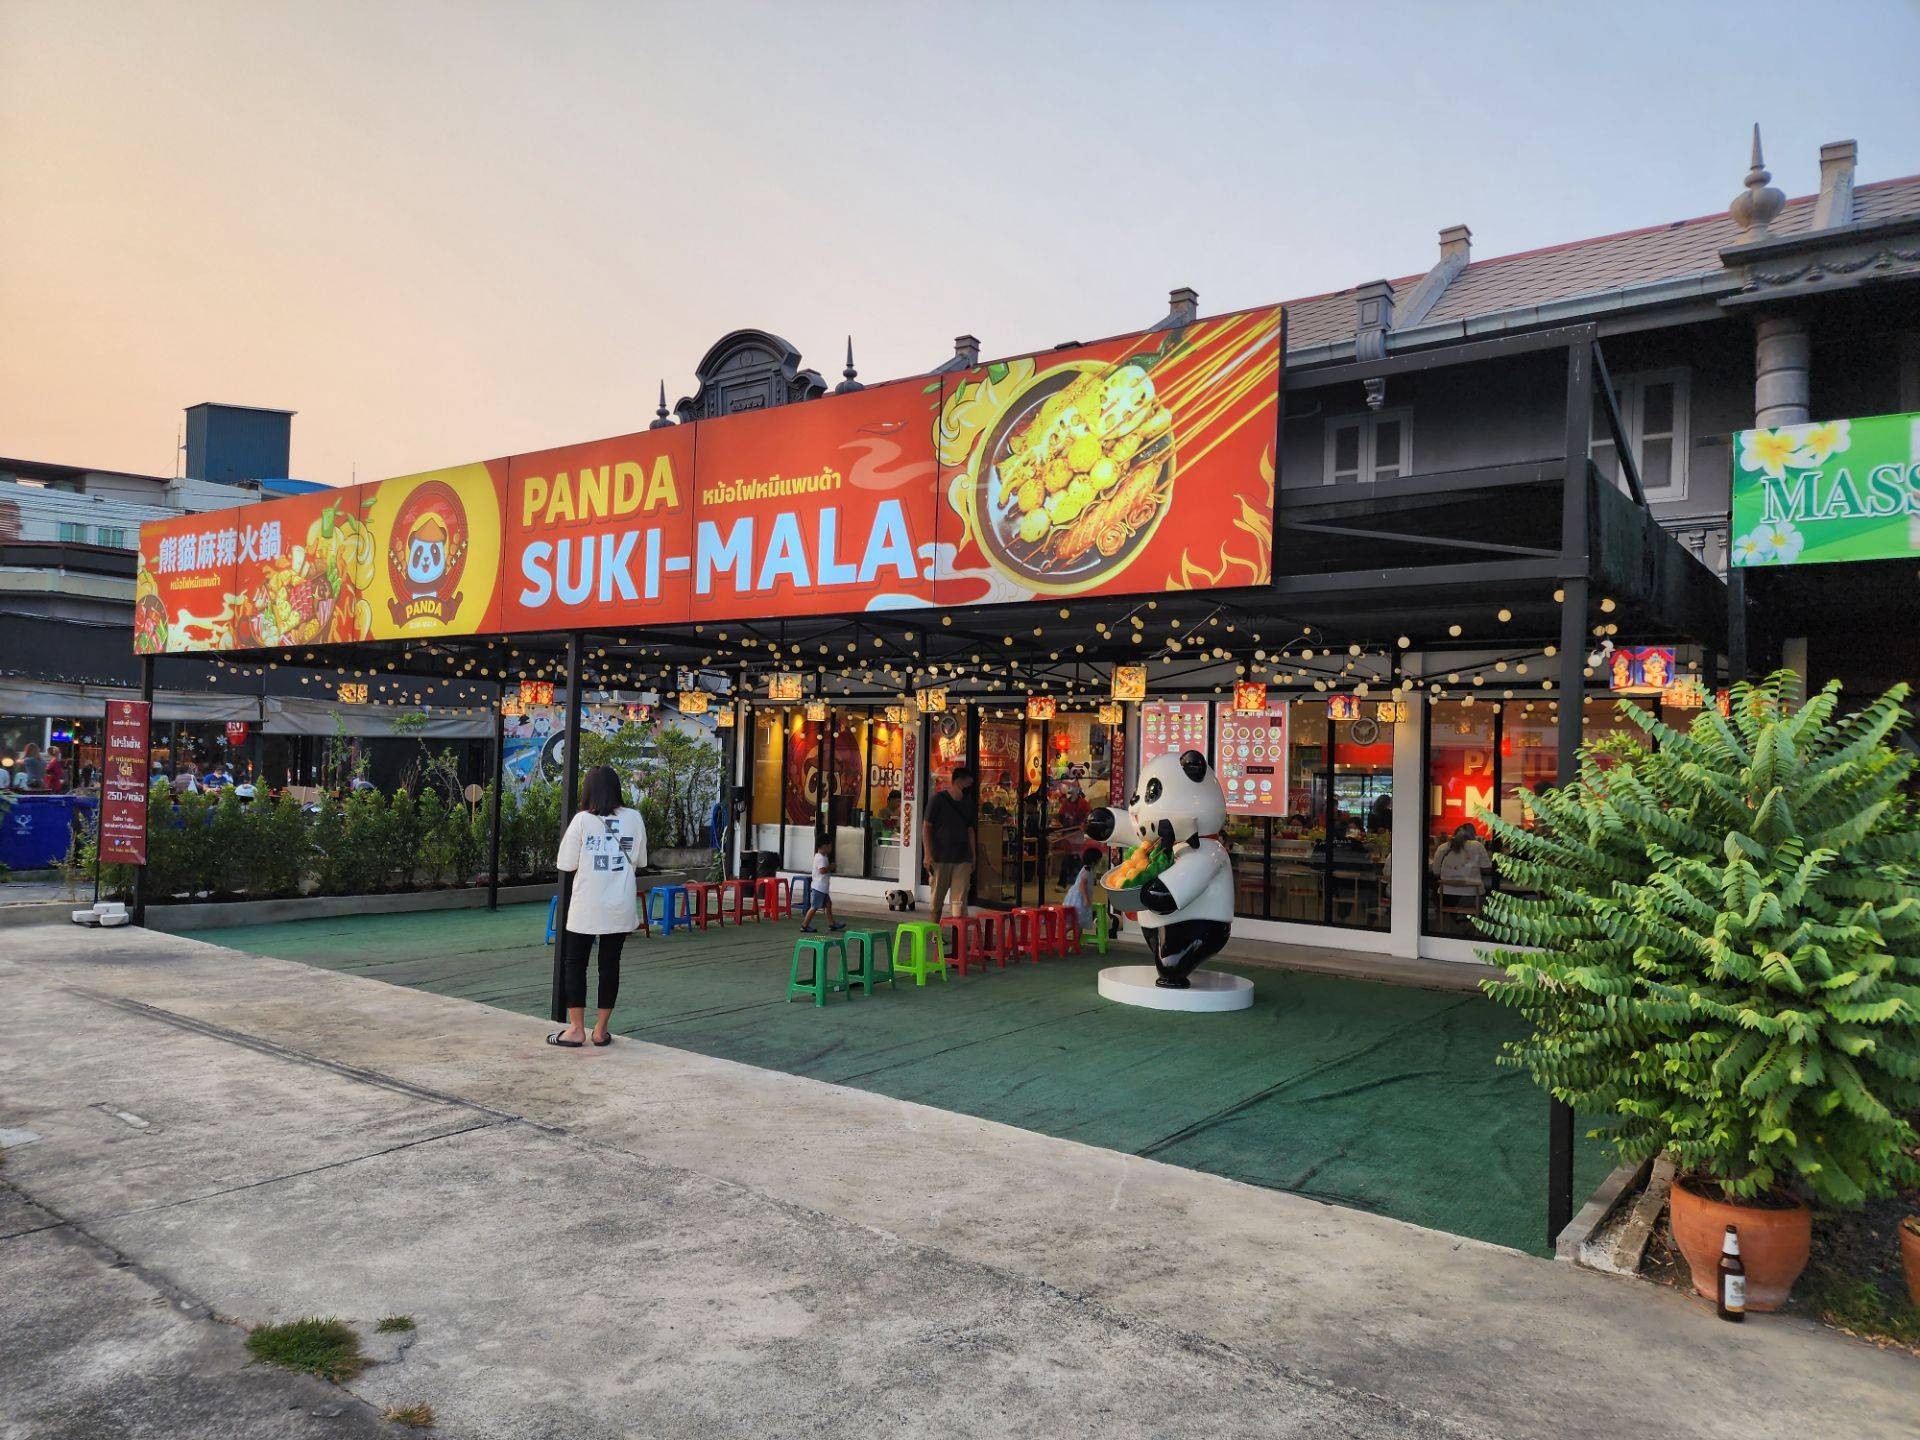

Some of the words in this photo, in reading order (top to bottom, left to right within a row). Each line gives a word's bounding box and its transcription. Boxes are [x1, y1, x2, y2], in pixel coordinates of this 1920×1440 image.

[522, 455, 679, 527] PANDA
[703, 466, 841, 505] หม้อไฟหมีแพนด้า
[519, 499, 918, 609] SUKI-MALA
[405, 600, 442, 619] PANDA
